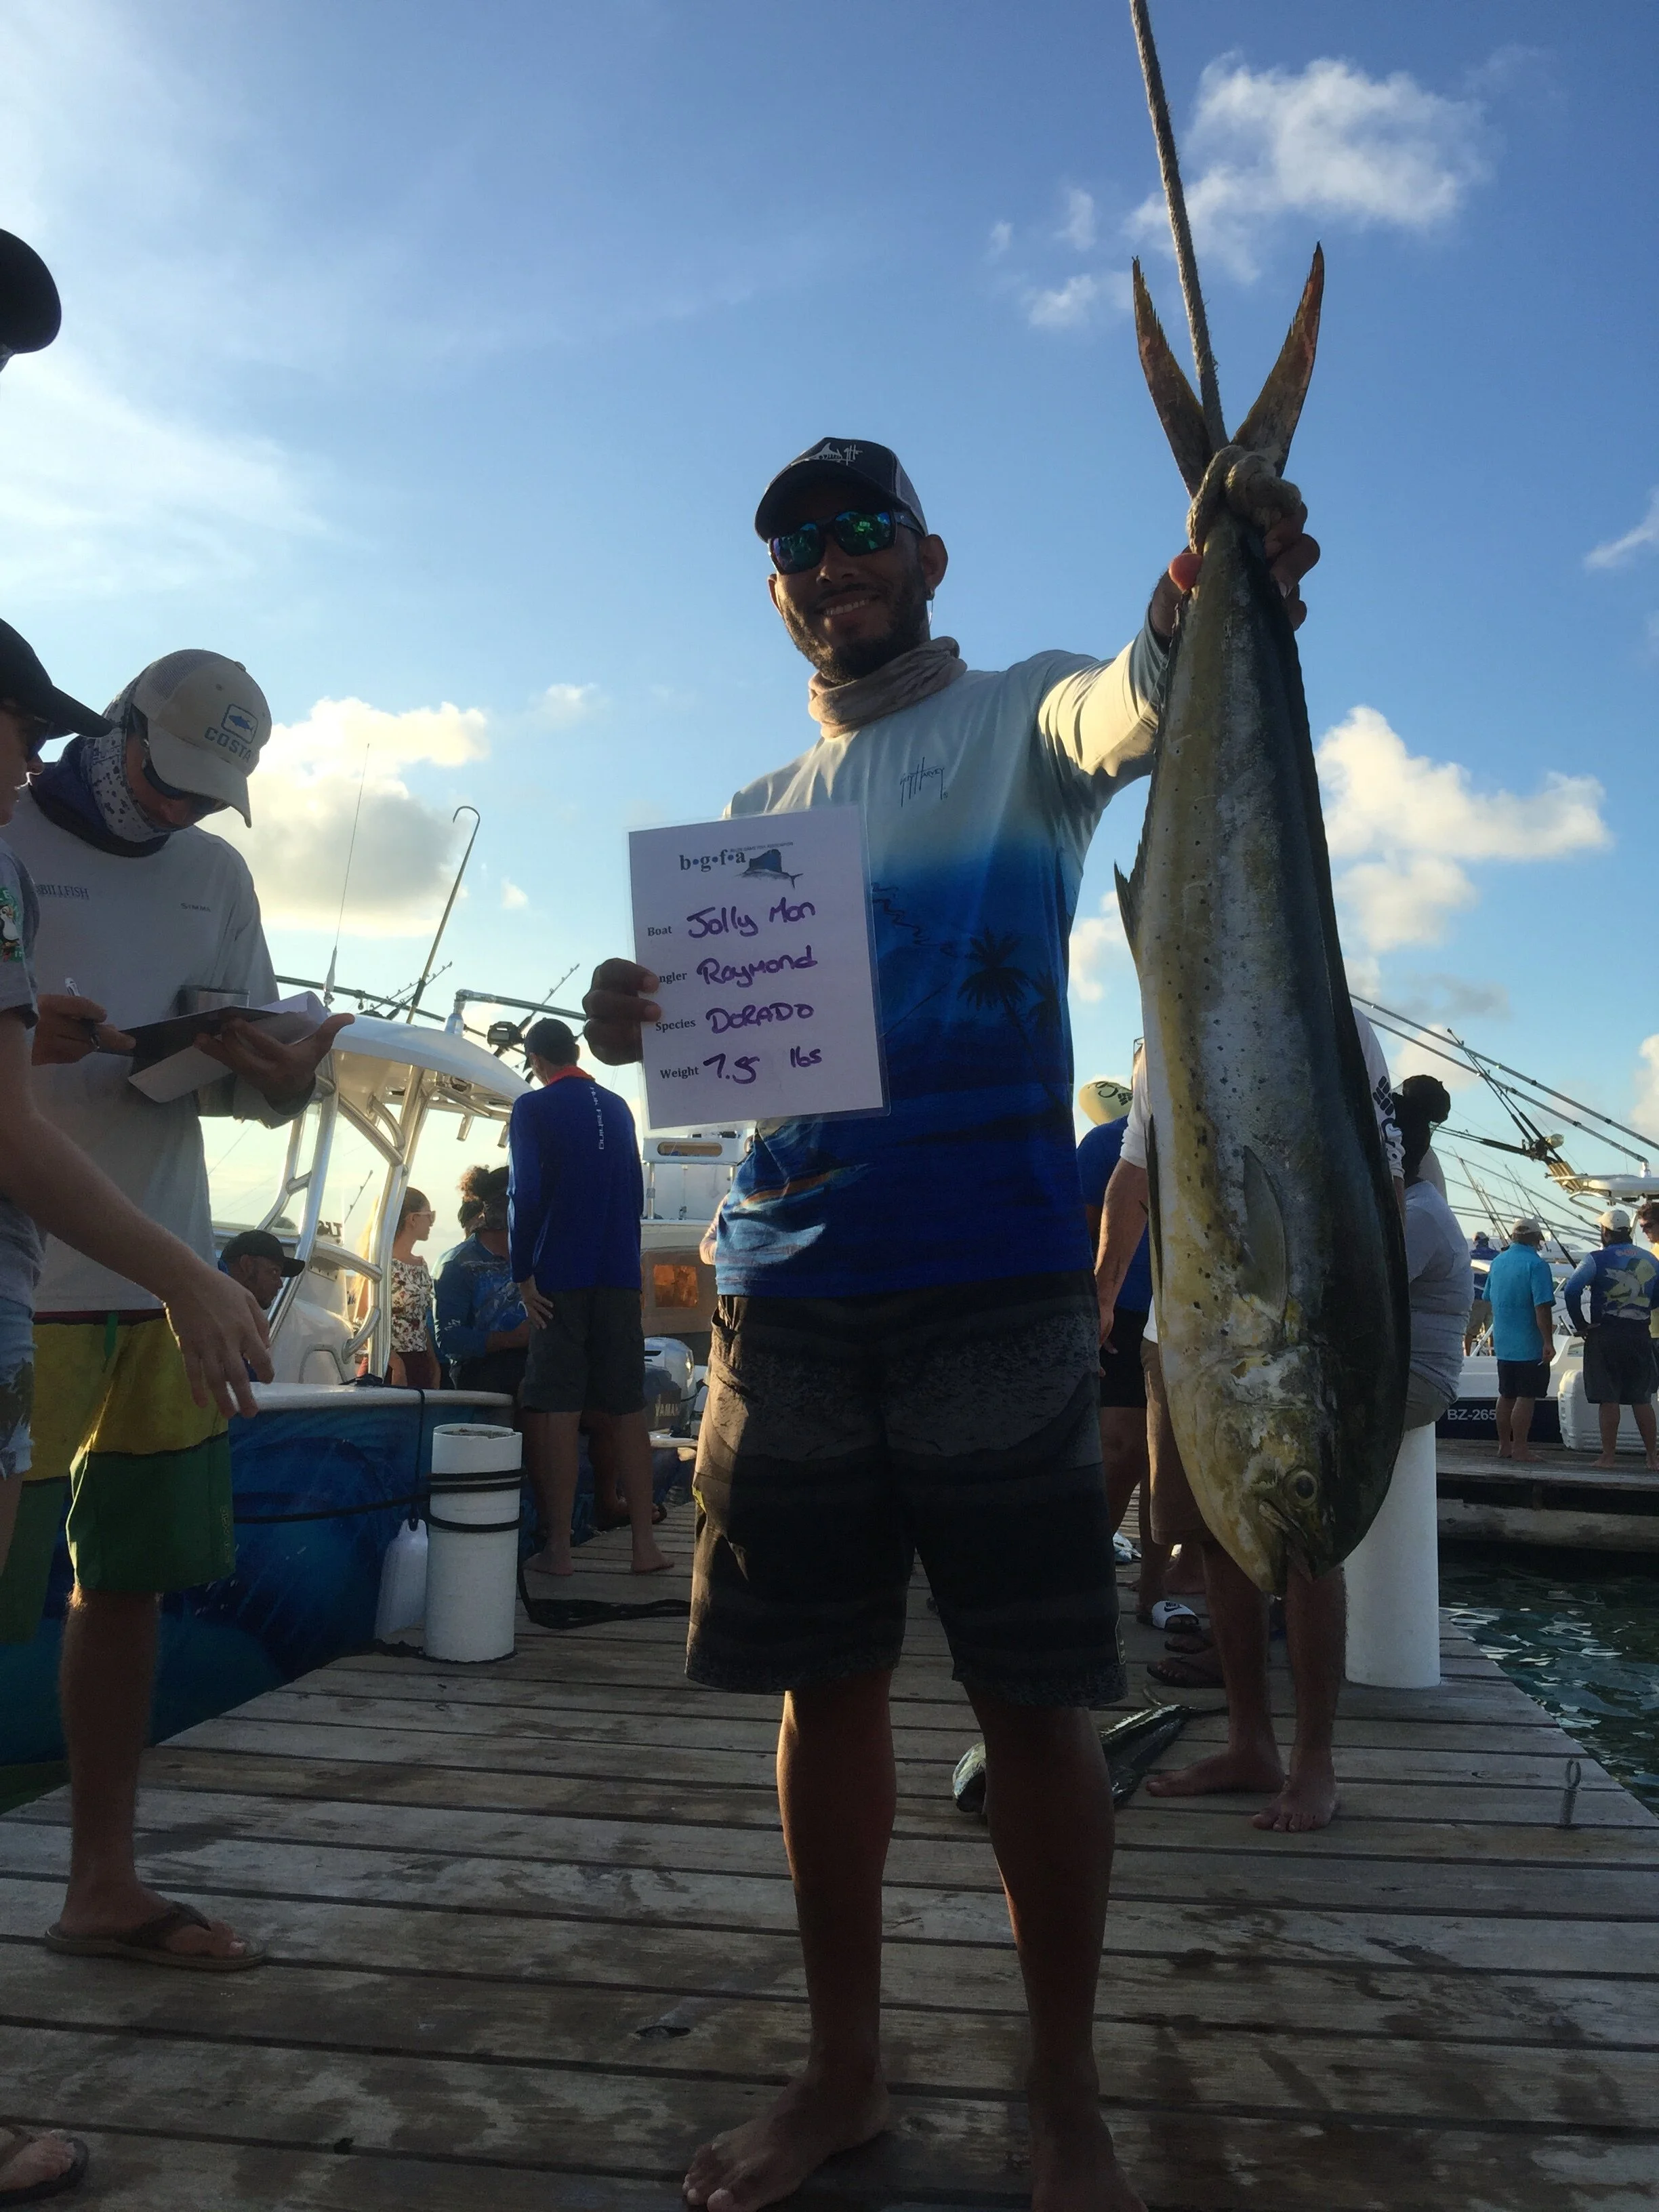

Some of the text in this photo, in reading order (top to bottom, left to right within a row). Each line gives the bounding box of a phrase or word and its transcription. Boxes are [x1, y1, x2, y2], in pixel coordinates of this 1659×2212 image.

[205, 726, 251, 763] COSTA
[686, 905, 758, 939] Jolly
[647, 926, 672, 937] Boat
[659, 970, 688, 985] ngler
[655, 1019, 696, 1032] Species
[660, 1066, 699, 1080] Weight
